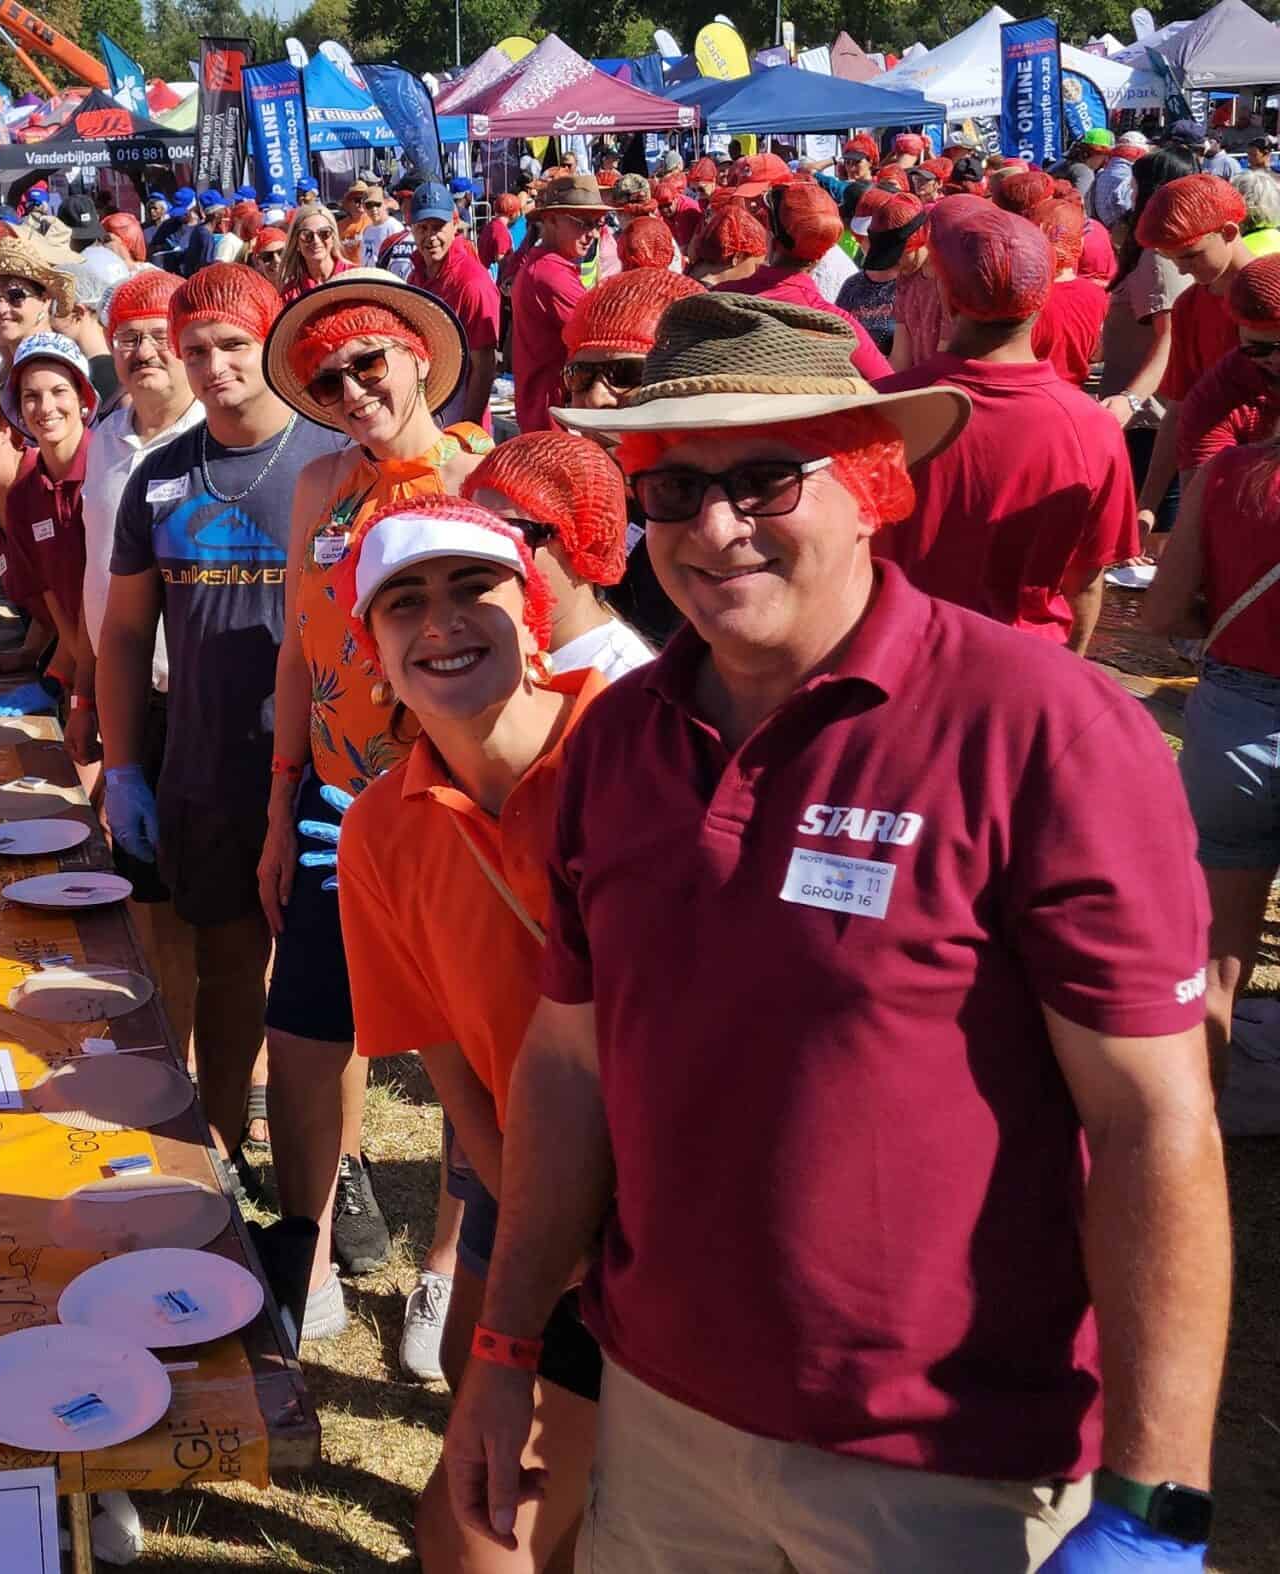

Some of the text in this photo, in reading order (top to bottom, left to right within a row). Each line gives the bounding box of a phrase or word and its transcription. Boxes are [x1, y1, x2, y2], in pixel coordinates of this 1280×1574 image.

[1017, 59, 1034, 133] ONLINE
[553, 111, 616, 131] Lumies
[261, 102, 285, 178] ONLINE
[25, 151, 111, 166] Vanderbijlpark
[116, 148, 140, 161] 016
[143, 147, 164, 160] 981
[801, 883, 873, 906] GROUP 16
